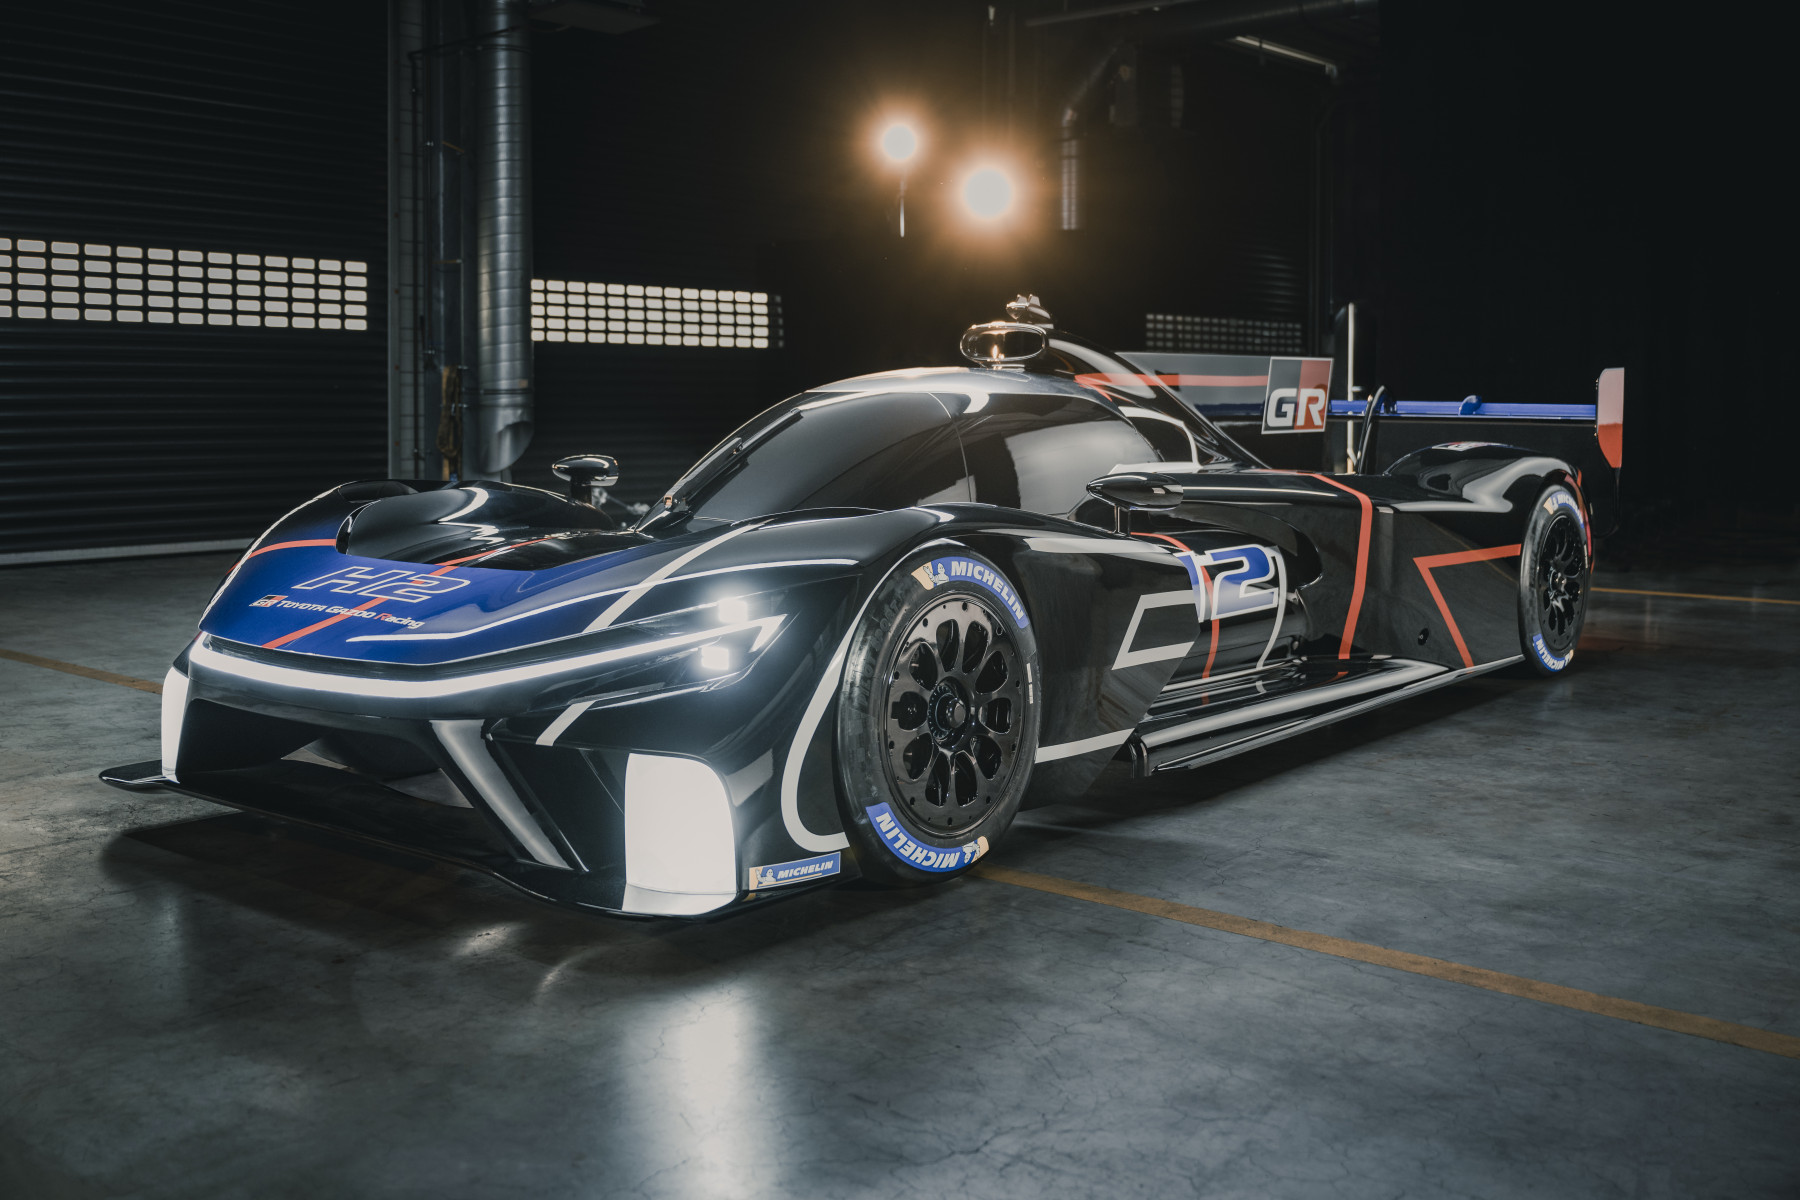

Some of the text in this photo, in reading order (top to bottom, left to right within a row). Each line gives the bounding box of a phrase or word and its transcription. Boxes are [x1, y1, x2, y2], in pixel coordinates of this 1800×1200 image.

[1267, 388, 1326, 427] GR
[291, 566, 471, 604] H2
[951, 560, 1024, 620] MICHELIN
[276, 600, 328, 612] TOYOTA
[325, 605, 376, 619] GAZOO
[374, 612, 425, 629] Racing
[1535, 638, 1566, 671] MICHELIN
[875, 811, 961, 869] MICHELIN
[777, 860, 834, 880] MICHELIN
